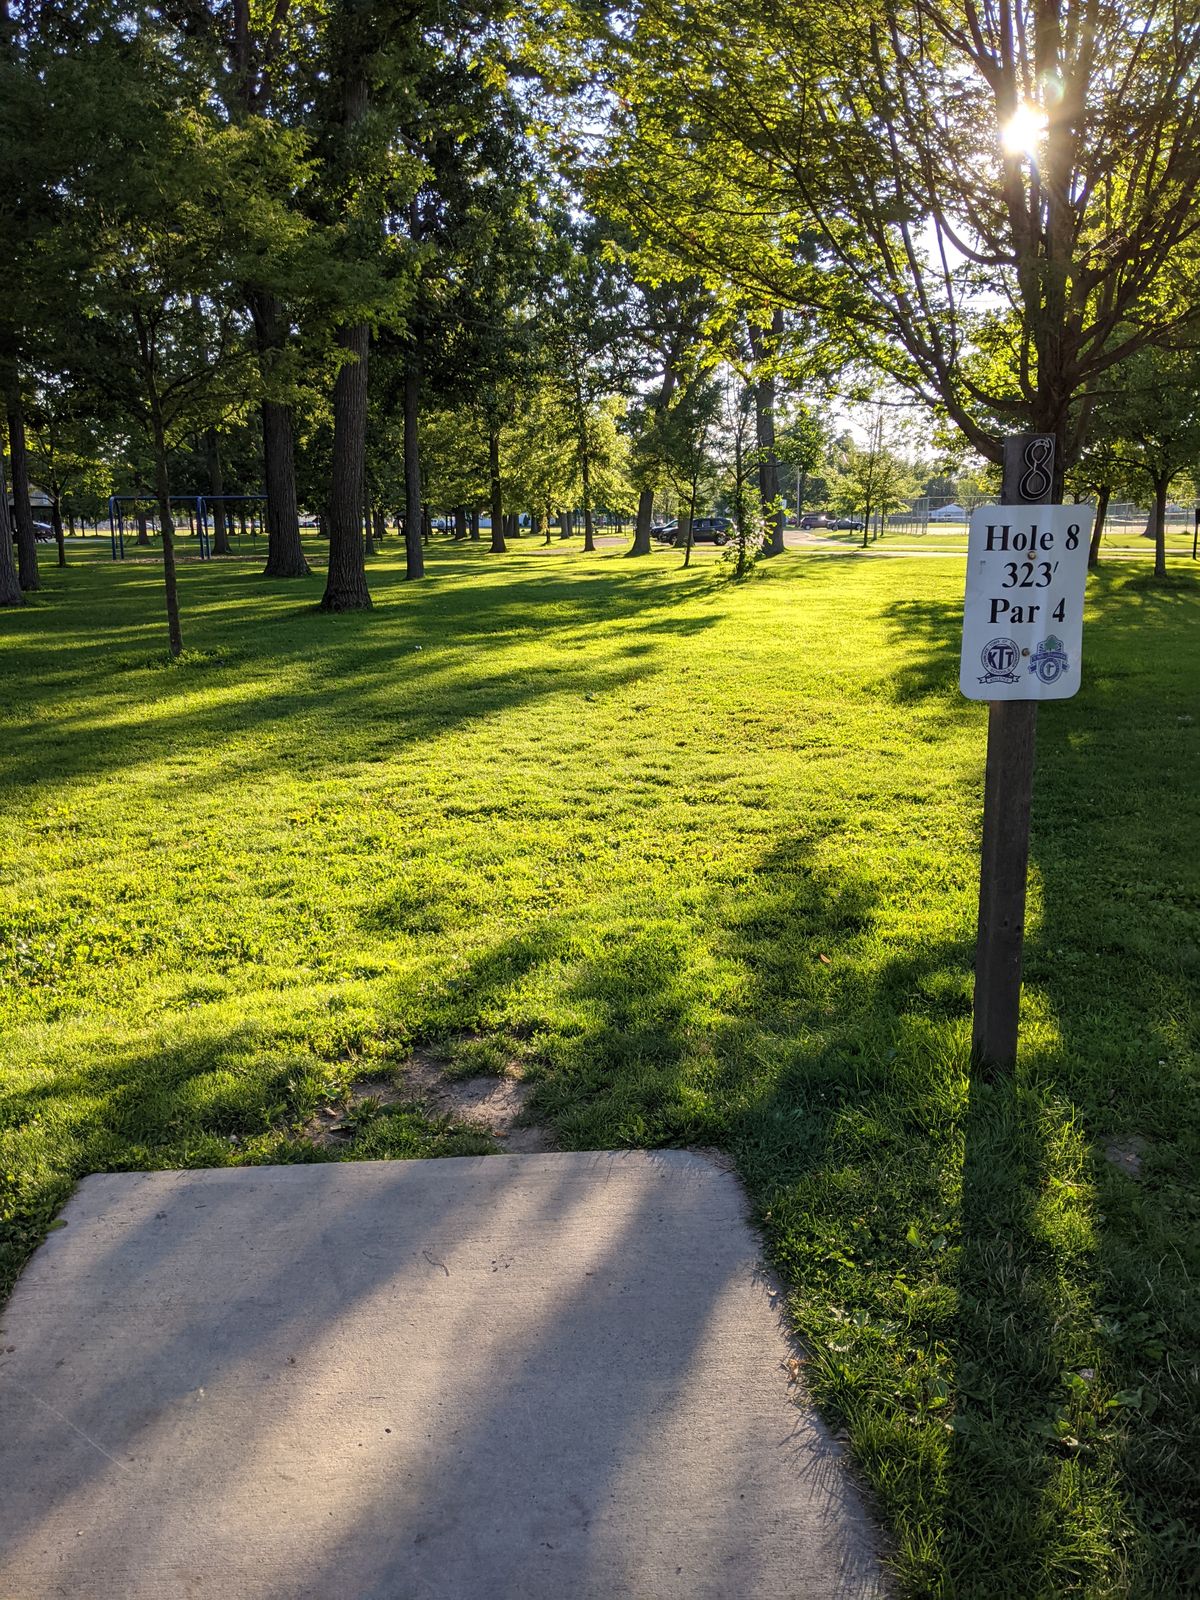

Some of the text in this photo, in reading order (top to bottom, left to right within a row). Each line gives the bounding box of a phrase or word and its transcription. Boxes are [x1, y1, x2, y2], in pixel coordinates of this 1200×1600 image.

[1019, 438, 1054, 500] 8
[983, 523, 1080, 552] Hole 8
[987, 597, 1066, 624] Par 4
